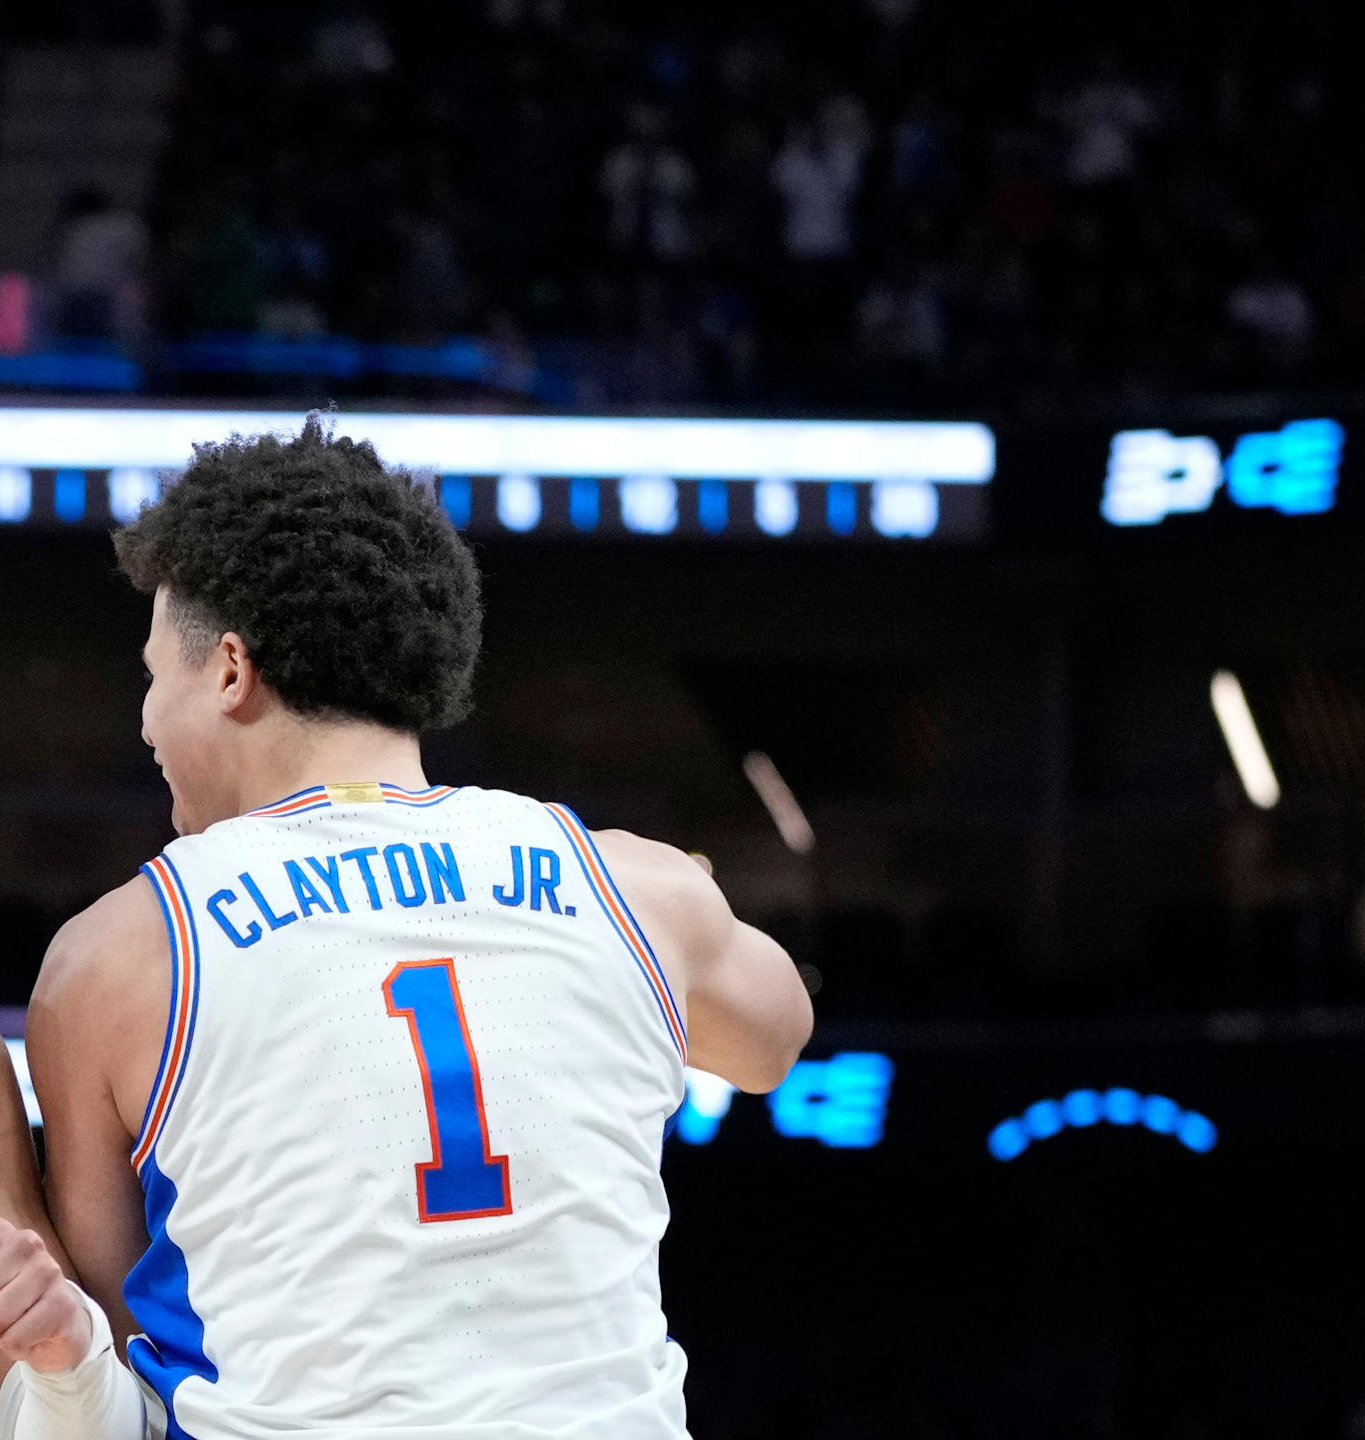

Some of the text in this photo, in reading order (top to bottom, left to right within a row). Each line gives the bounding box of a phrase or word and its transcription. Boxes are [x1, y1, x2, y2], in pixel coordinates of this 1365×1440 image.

[206, 842, 577, 948] CLAYTON JR.
[382, 958, 514, 1224] 1
